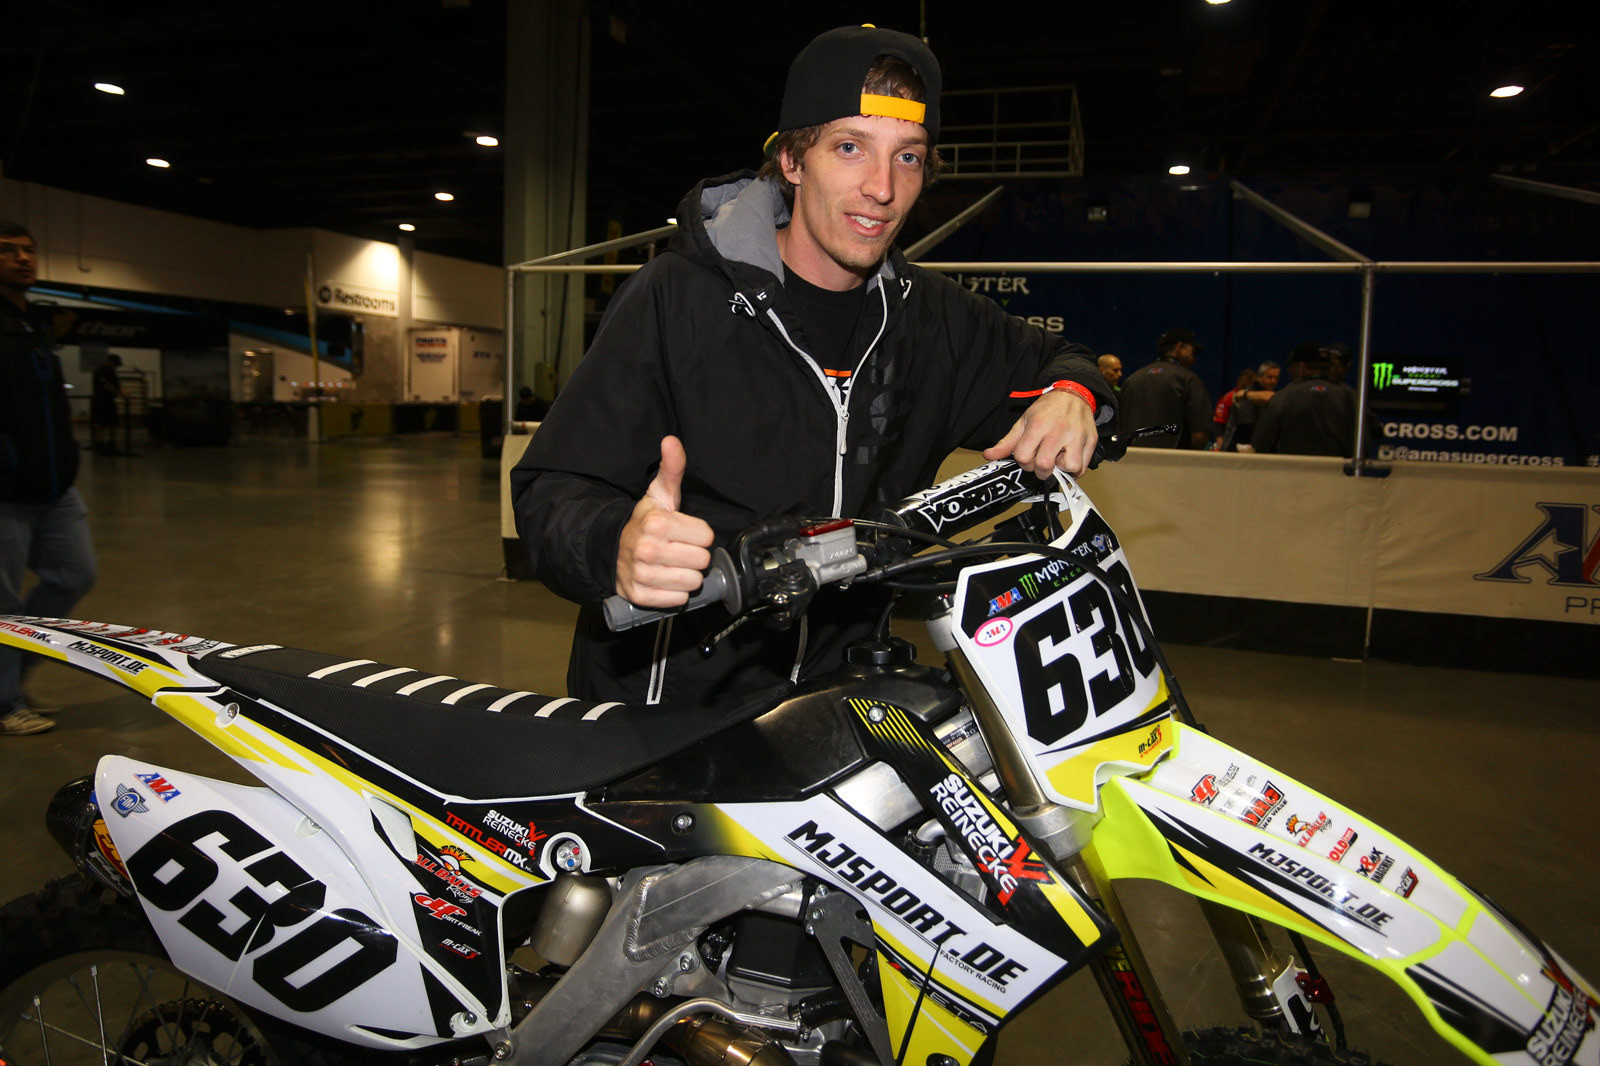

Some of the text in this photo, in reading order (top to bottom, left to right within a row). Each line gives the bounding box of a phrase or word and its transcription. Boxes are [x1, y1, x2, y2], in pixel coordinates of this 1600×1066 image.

[335, 288, 395, 312] Restrooms
[1383, 422, 1518, 441] CROSS.COM
[918, 469, 1026, 533] VORTEX
[987, 587, 1024, 617] AMA
[67, 640, 149, 673] MJSPORT.DE
[1013, 559, 1157, 746] 630
[132, 771, 182, 804] AMA
[486, 809, 530, 837] SUZUKI
[942, 773, 1014, 858] SUZUKI
[482, 815, 537, 851] REINECKE
[929, 782, 1019, 894] REINECKE
[434, 866, 484, 898] BALLS
[446, 885, 475, 904] Racing
[125, 809, 399, 1013] 630
[788, 819, 1029, 985] MJSPORT.DE
[456, 920, 482, 936] FREAK
[940, 949, 1007, 994] FACTORY RACING
[907, 973, 988, 1034] ZETA
